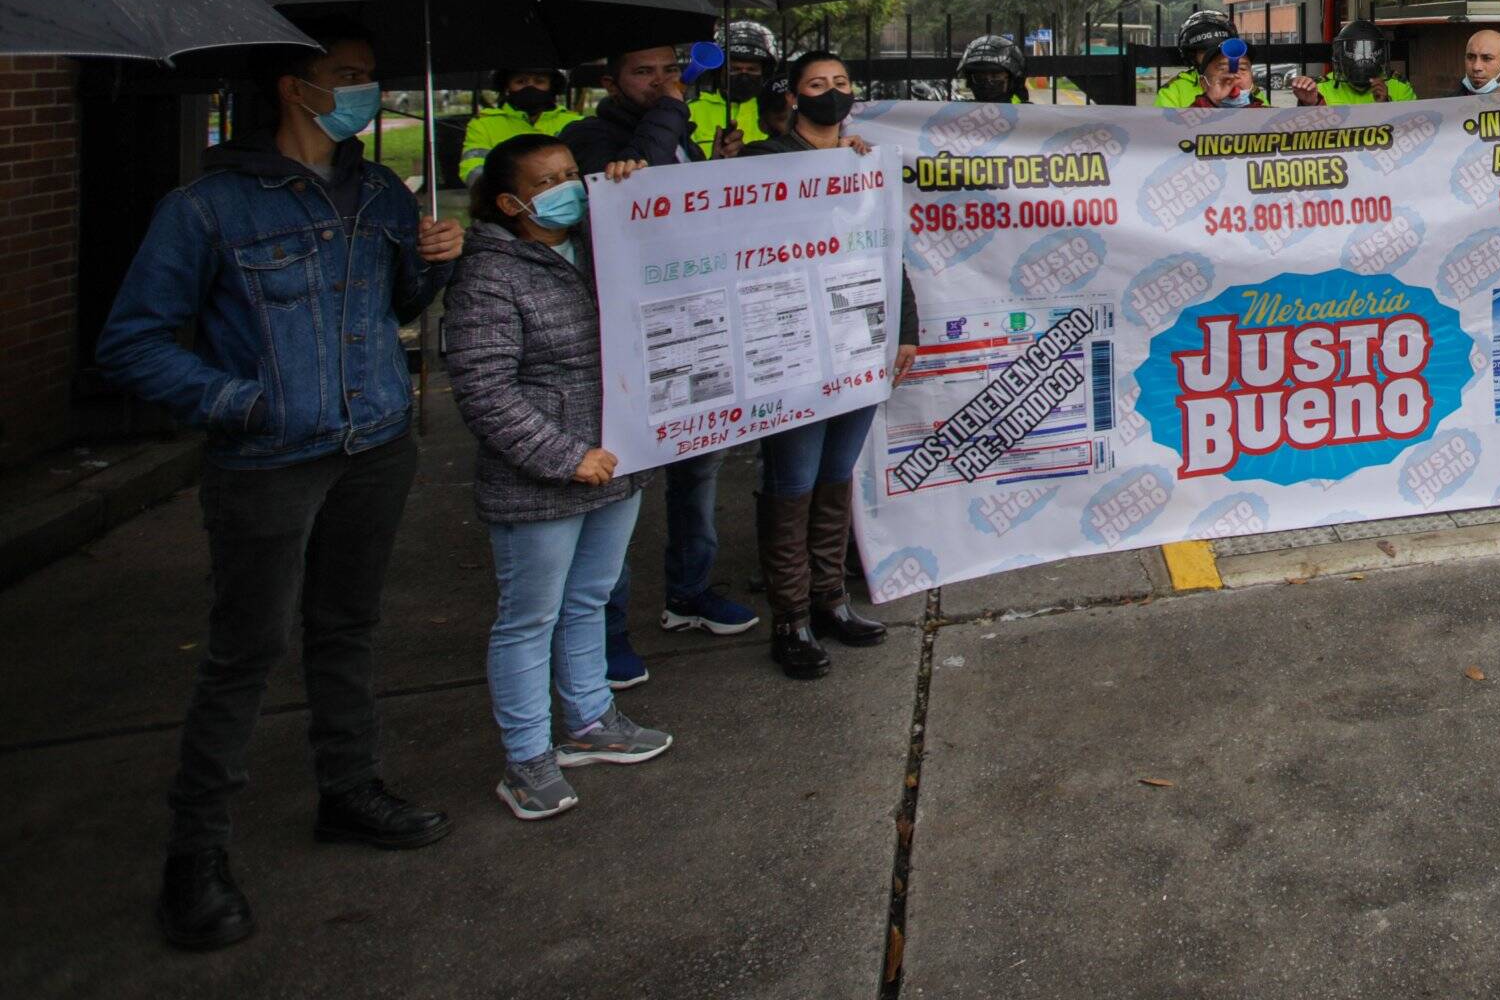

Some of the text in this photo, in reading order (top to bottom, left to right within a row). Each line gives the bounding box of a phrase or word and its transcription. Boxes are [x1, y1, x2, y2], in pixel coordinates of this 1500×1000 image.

[1196, 125, 1392, 157] INCUMPLIMIENTOS
[917, 151, 1106, 188] DÉFICIT DE CAJA
[1249, 157, 1346, 190] LABORES
[631, 196, 671, 220] NO
[684, 190, 709, 213] ES
[799, 178, 821, 199] NI
[826, 170, 884, 196] BUENO
[909, 198, 1119, 235] $96.583.000.000
[1204, 196, 1392, 236] $43.801.000.000
[642, 252, 728, 286] DEBEN
[1242, 288, 1410, 327] Mercadería
[943, 381, 1010, 448] TIENEN
[1003, 359, 1043, 406] EN
[1031, 309, 1093, 379] COBRO
[751, 399, 783, 419] AGUA
[953, 361, 1084, 482] PRE-JURIDICO!
[676, 430, 729, 456] DEBEN
